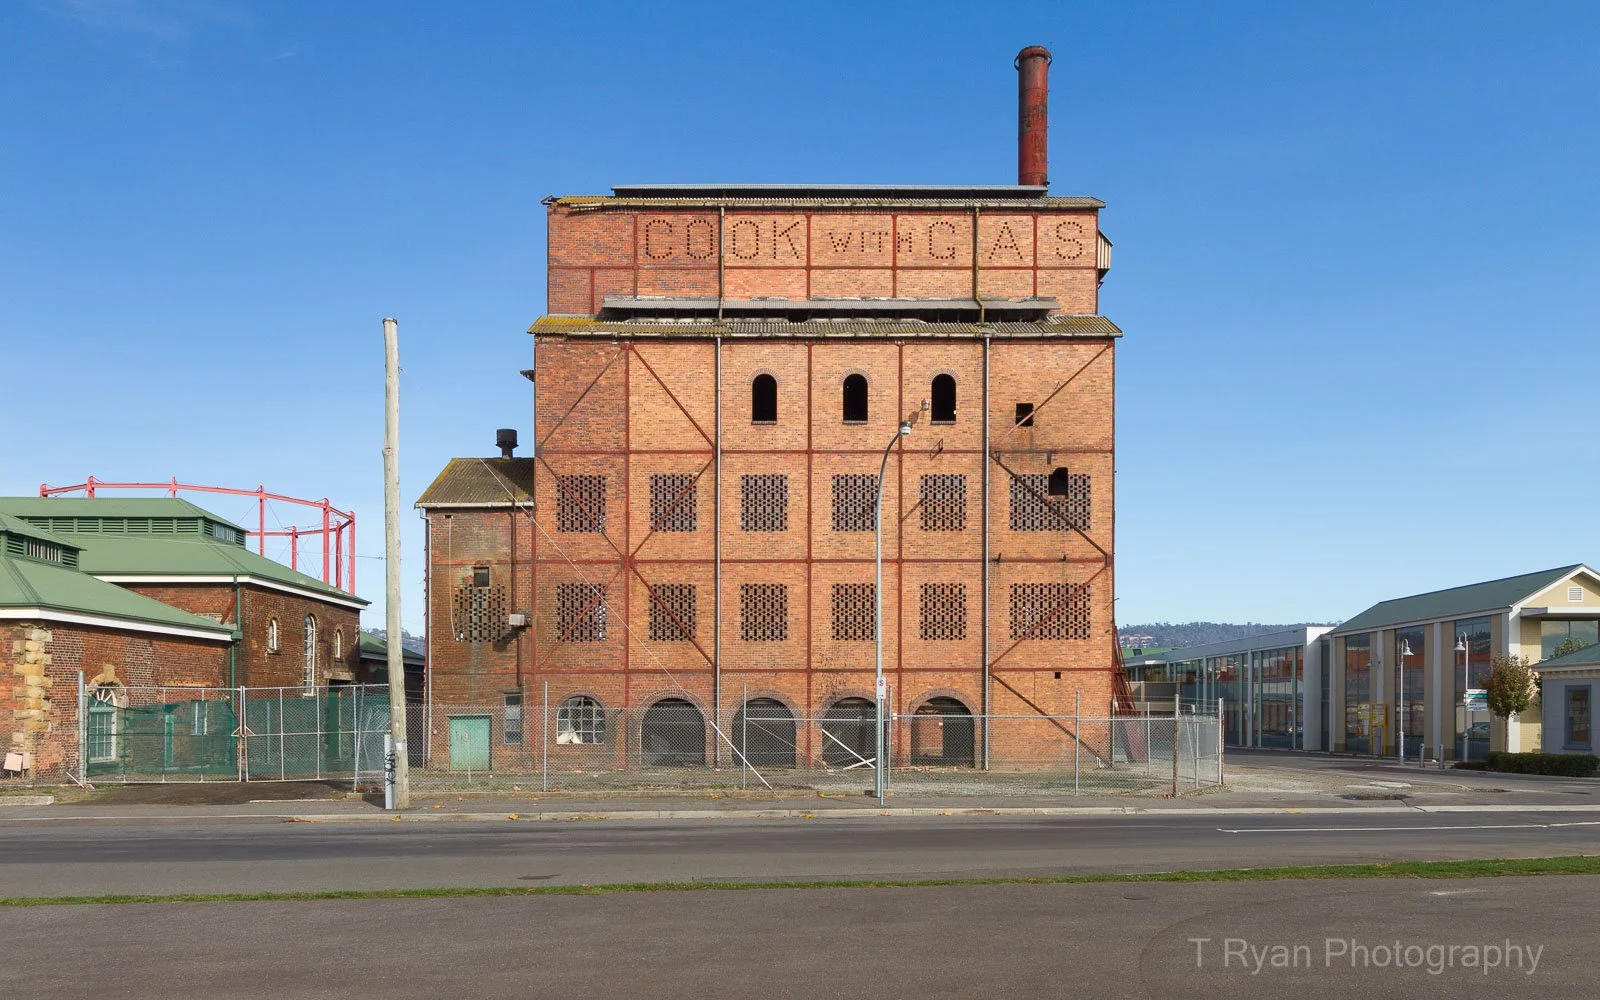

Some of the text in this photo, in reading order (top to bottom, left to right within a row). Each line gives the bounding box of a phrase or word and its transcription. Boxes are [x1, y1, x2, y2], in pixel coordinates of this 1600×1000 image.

[645, 218, 1084, 261] COOK WITH GAS
